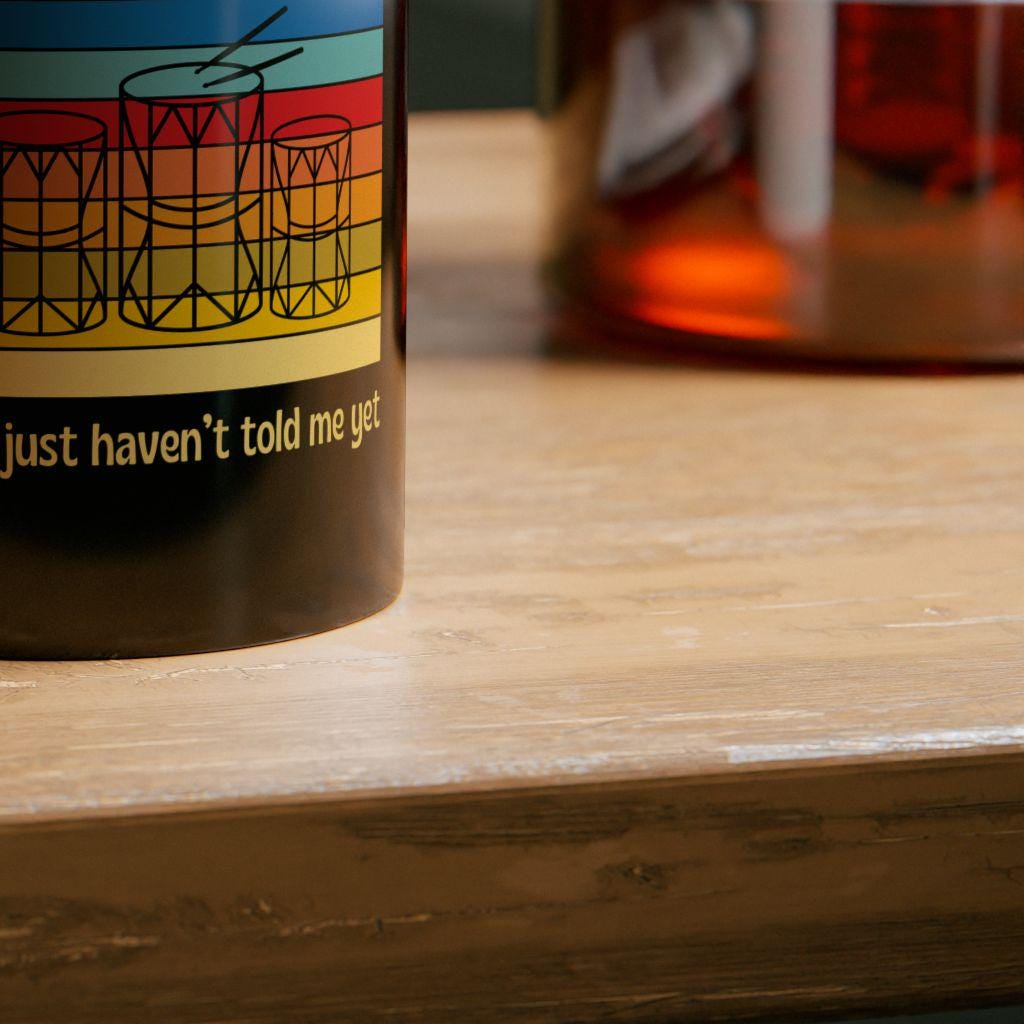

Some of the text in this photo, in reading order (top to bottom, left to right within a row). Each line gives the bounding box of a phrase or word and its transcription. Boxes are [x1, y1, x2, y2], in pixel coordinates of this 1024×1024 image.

[0, 422, 78, 480] just
[240, 406, 300, 457] told
[308, 409, 345, 447] me
[350, 390, 381, 449] yet
